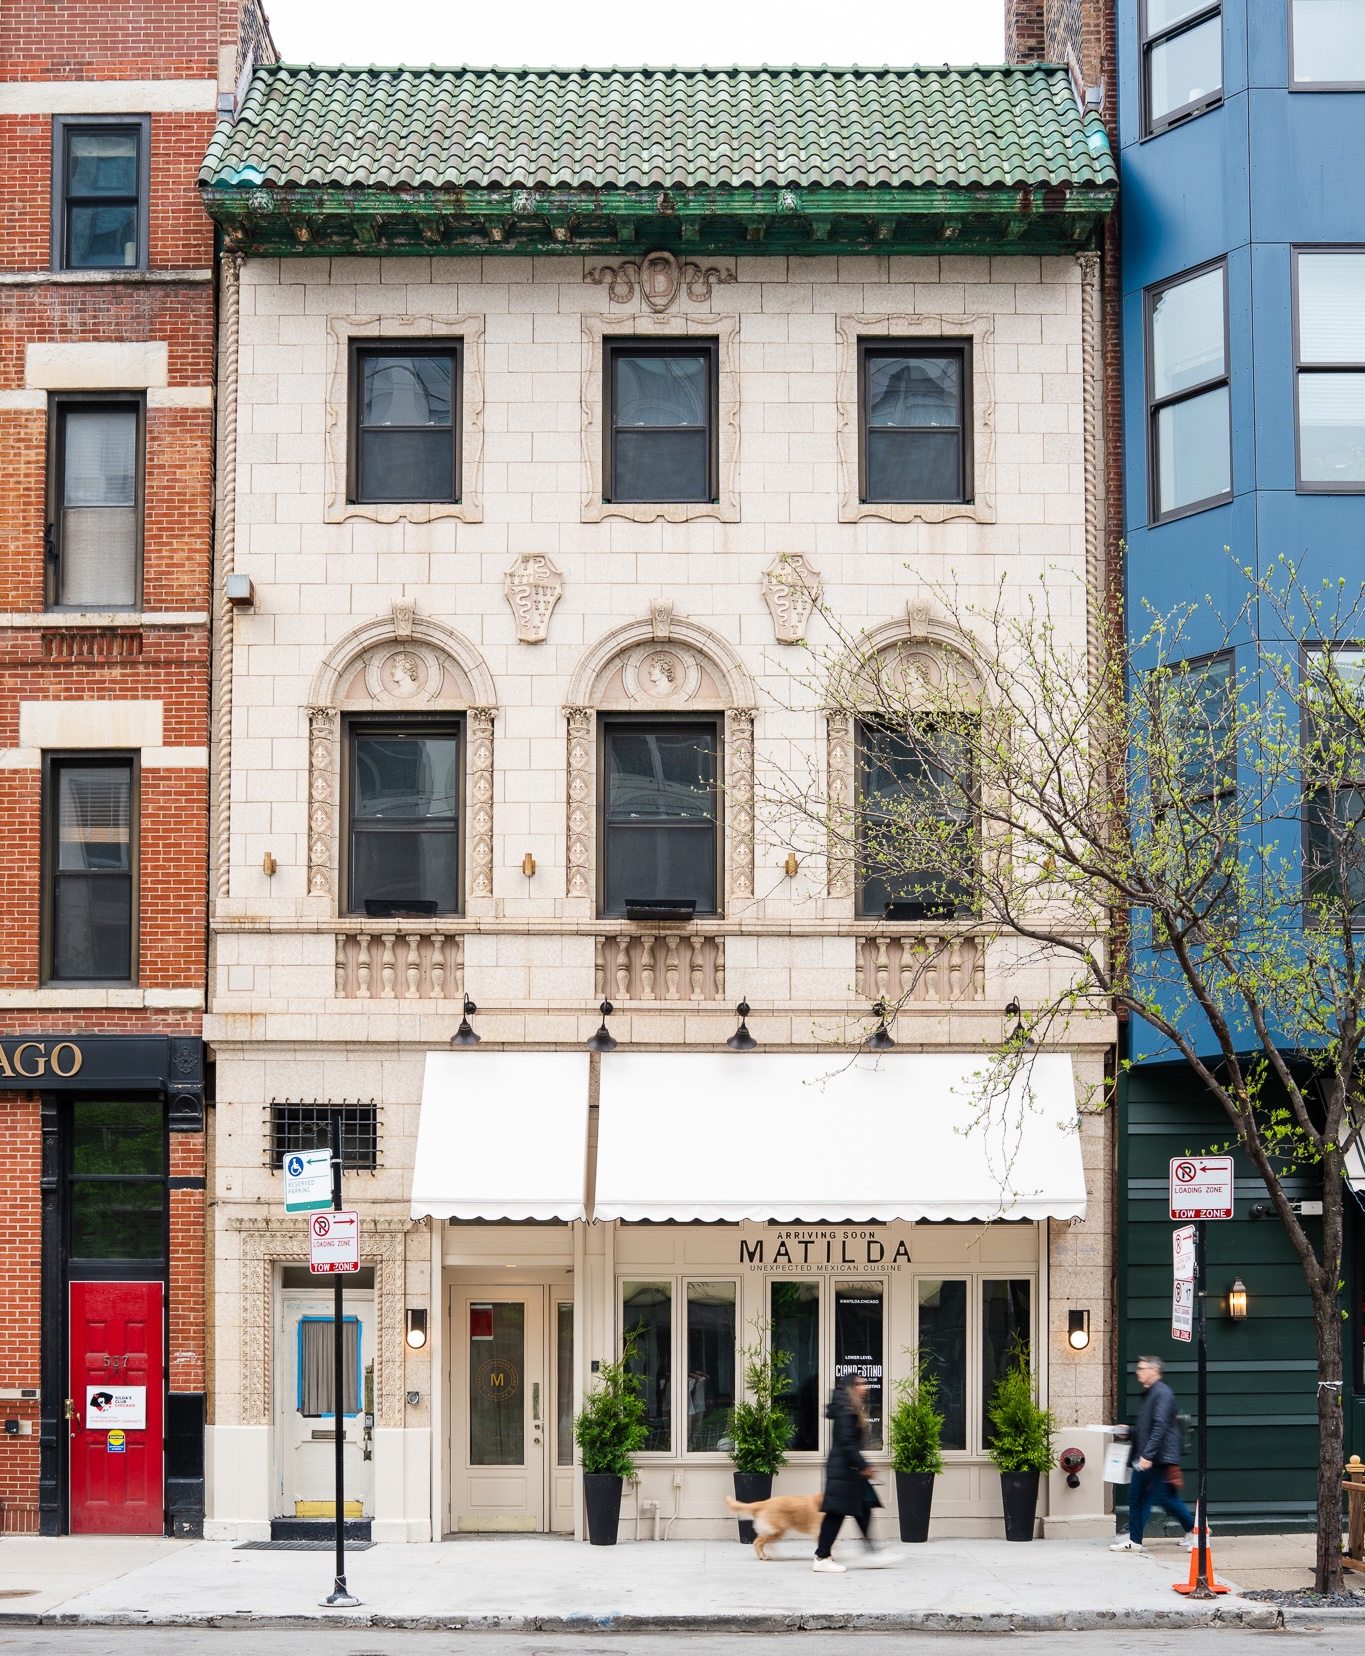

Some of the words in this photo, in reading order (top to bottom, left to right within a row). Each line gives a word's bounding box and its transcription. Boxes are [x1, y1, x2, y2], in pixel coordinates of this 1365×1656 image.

[648, 260, 673, 297] B
[288, 1180, 315, 1188] RESERVED
[288, 1187, 310, 1195] PARKING
[1175, 1210, 1195, 1218] TOW
[1200, 1210, 1226, 1218] ZONE
[843, 1231, 875, 1239] SOON
[740, 1240, 912, 1263] MATILDA
[313, 1263, 331, 1271] TOW
[334, 1263, 355, 1271] ZONE
[104, 1356, 129, 1367] 537
[490, 1373, 504, 1386] M
